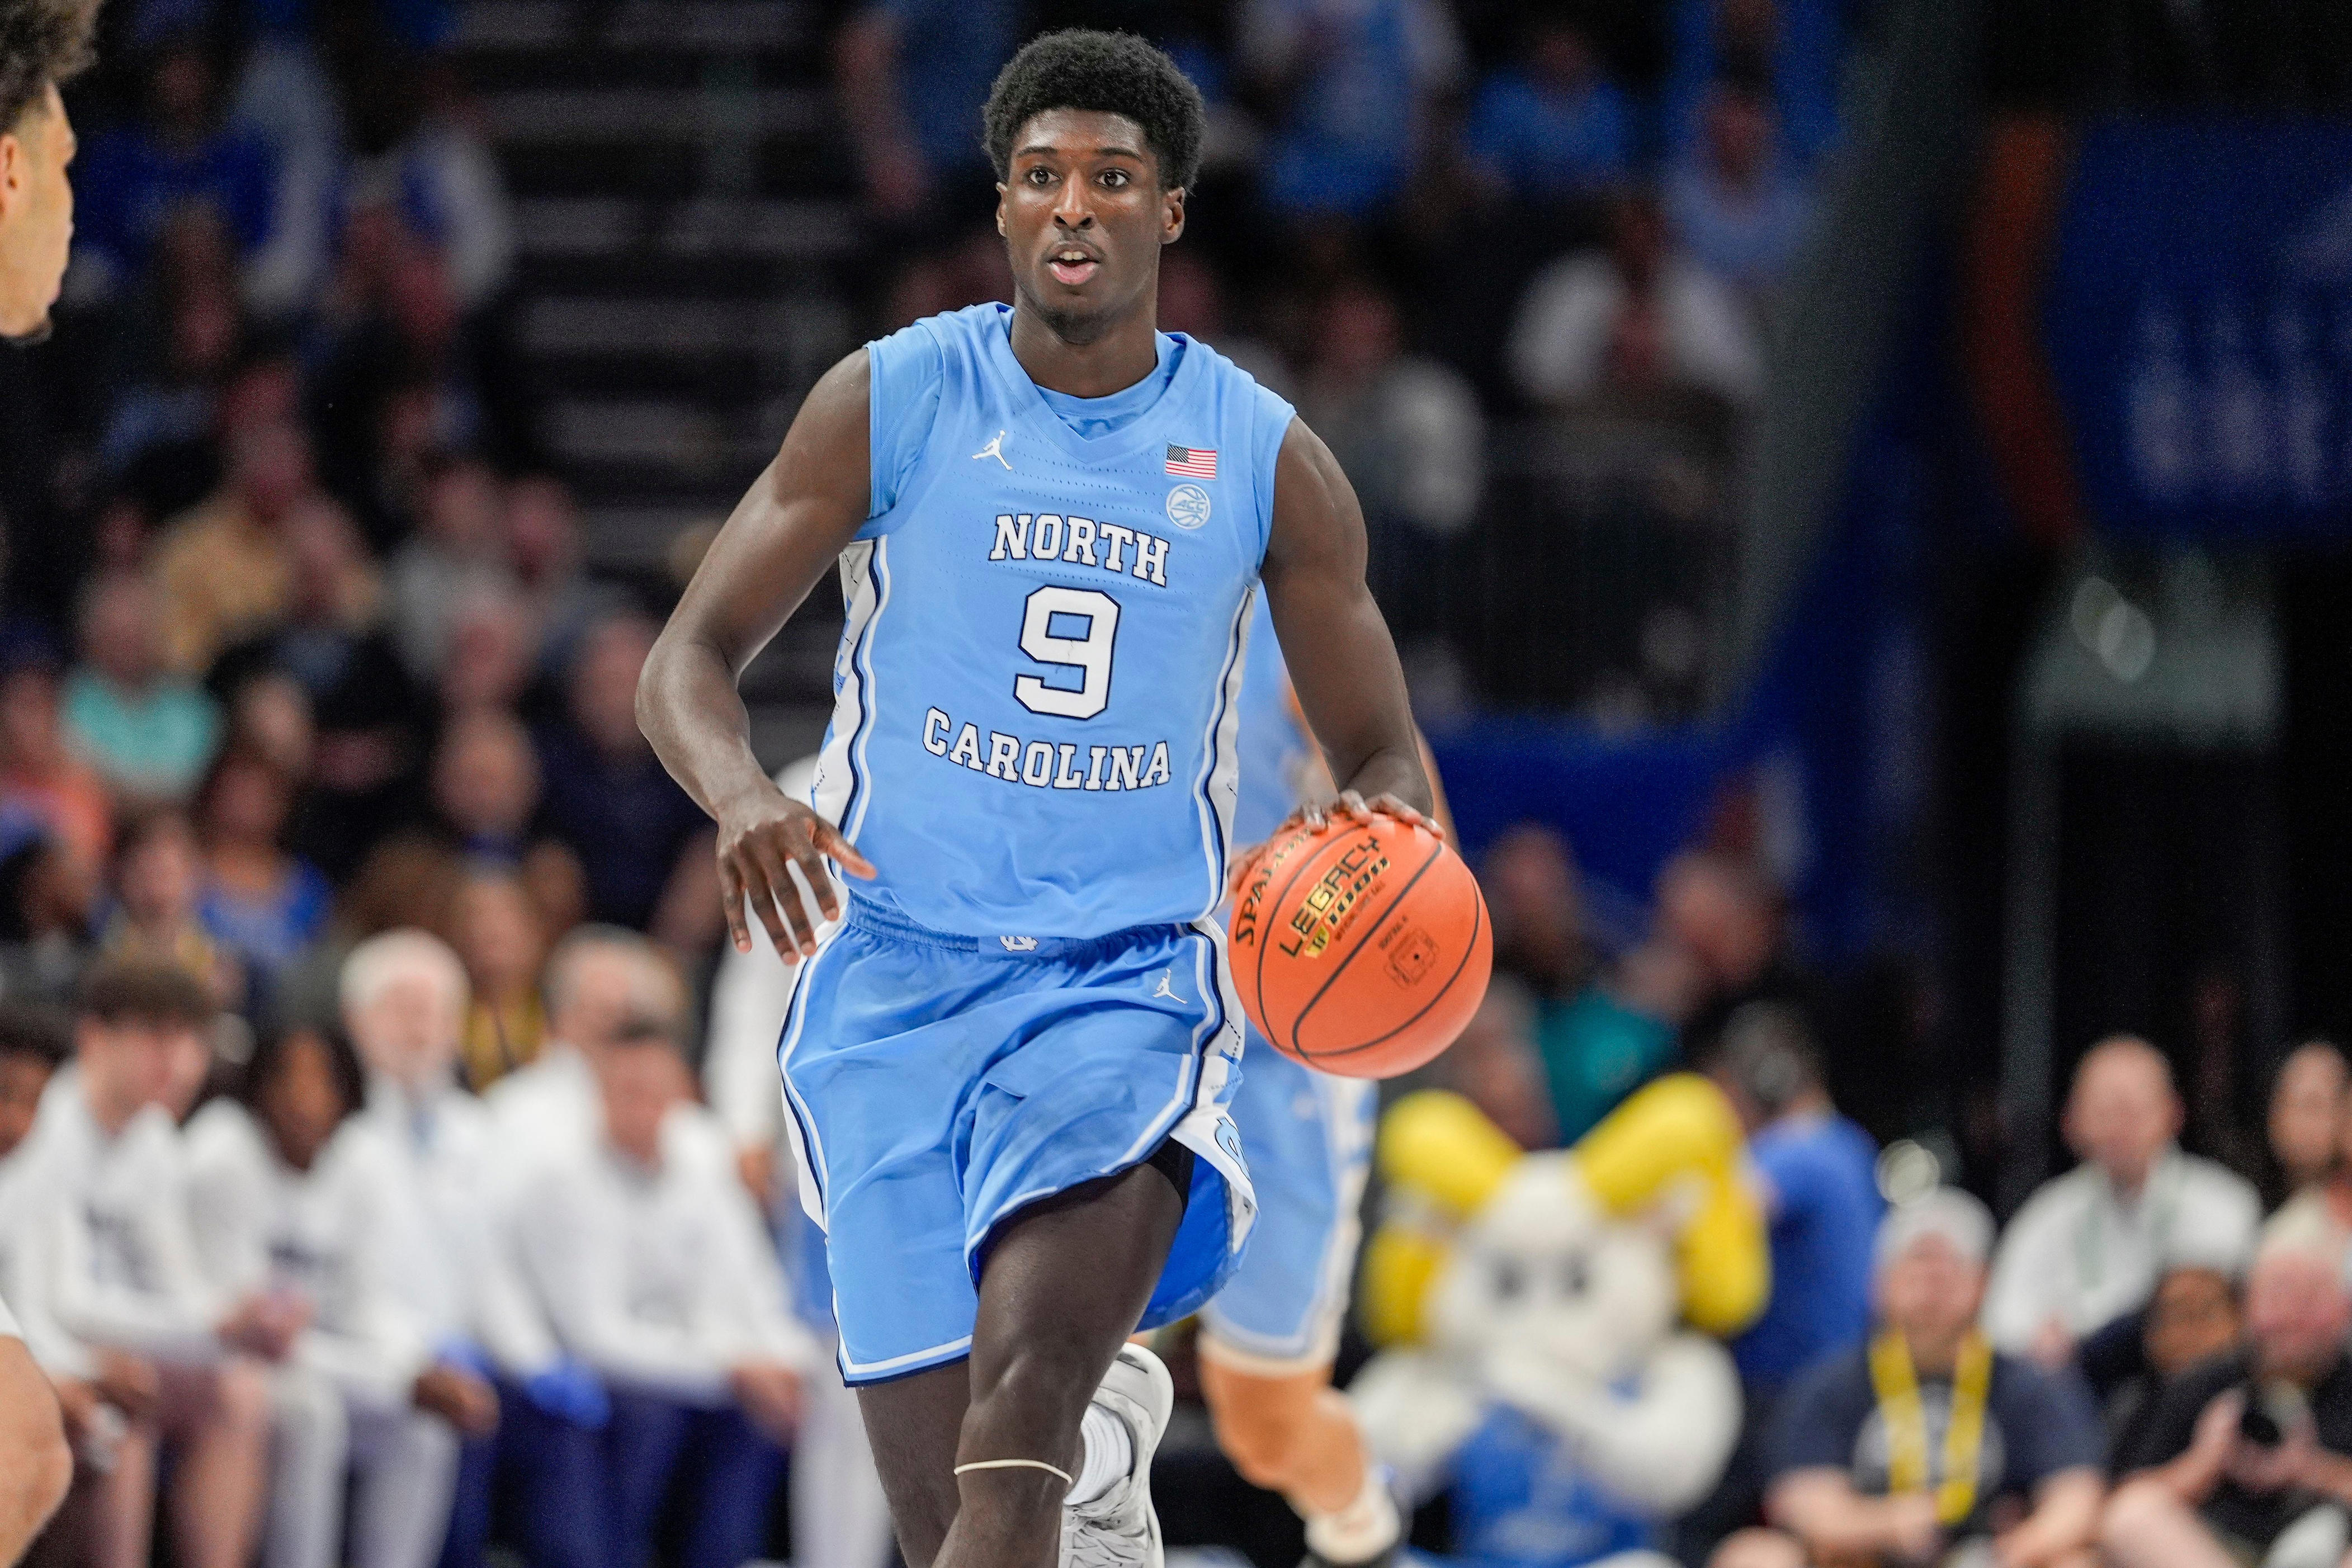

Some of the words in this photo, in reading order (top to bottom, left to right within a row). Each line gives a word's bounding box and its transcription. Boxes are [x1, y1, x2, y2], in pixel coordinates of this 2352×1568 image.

[989, 514, 1170, 588] NORTH
[1012, 584, 1121, 722] 9
[922, 706, 1172, 791] CAROLINA
[1279, 835, 1380, 957] LEGACY
